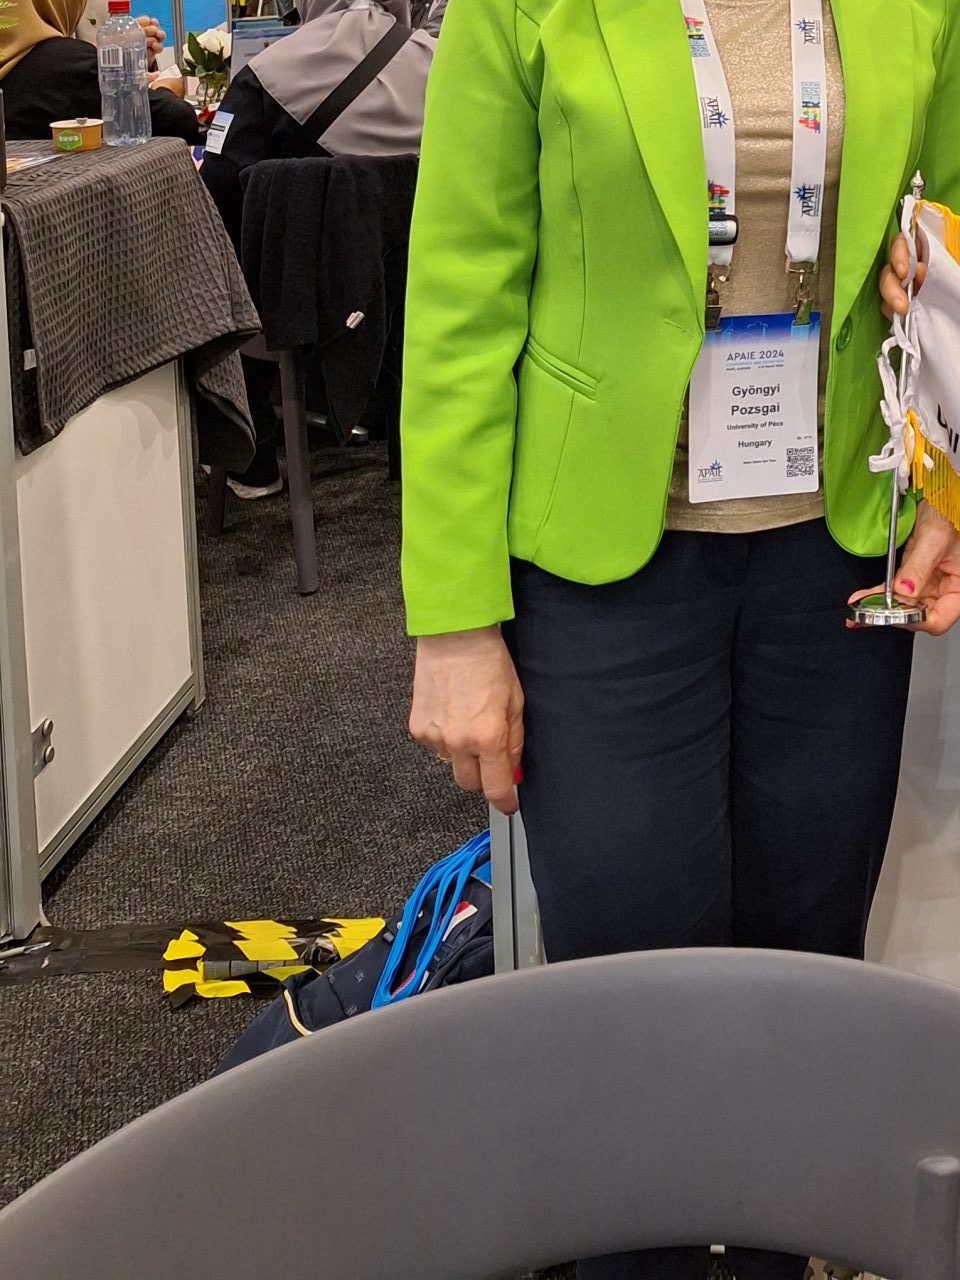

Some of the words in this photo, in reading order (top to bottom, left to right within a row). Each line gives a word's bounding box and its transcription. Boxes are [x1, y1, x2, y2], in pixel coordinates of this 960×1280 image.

[726, 351, 757, 362] APAIE
[759, 350, 784, 359] 2024
[732, 384, 780, 397] Gyöngyi
[731, 402, 780, 416] Pozsgai
[727, 422, 759, 431] University
[738, 439, 773, 449] Hungary
